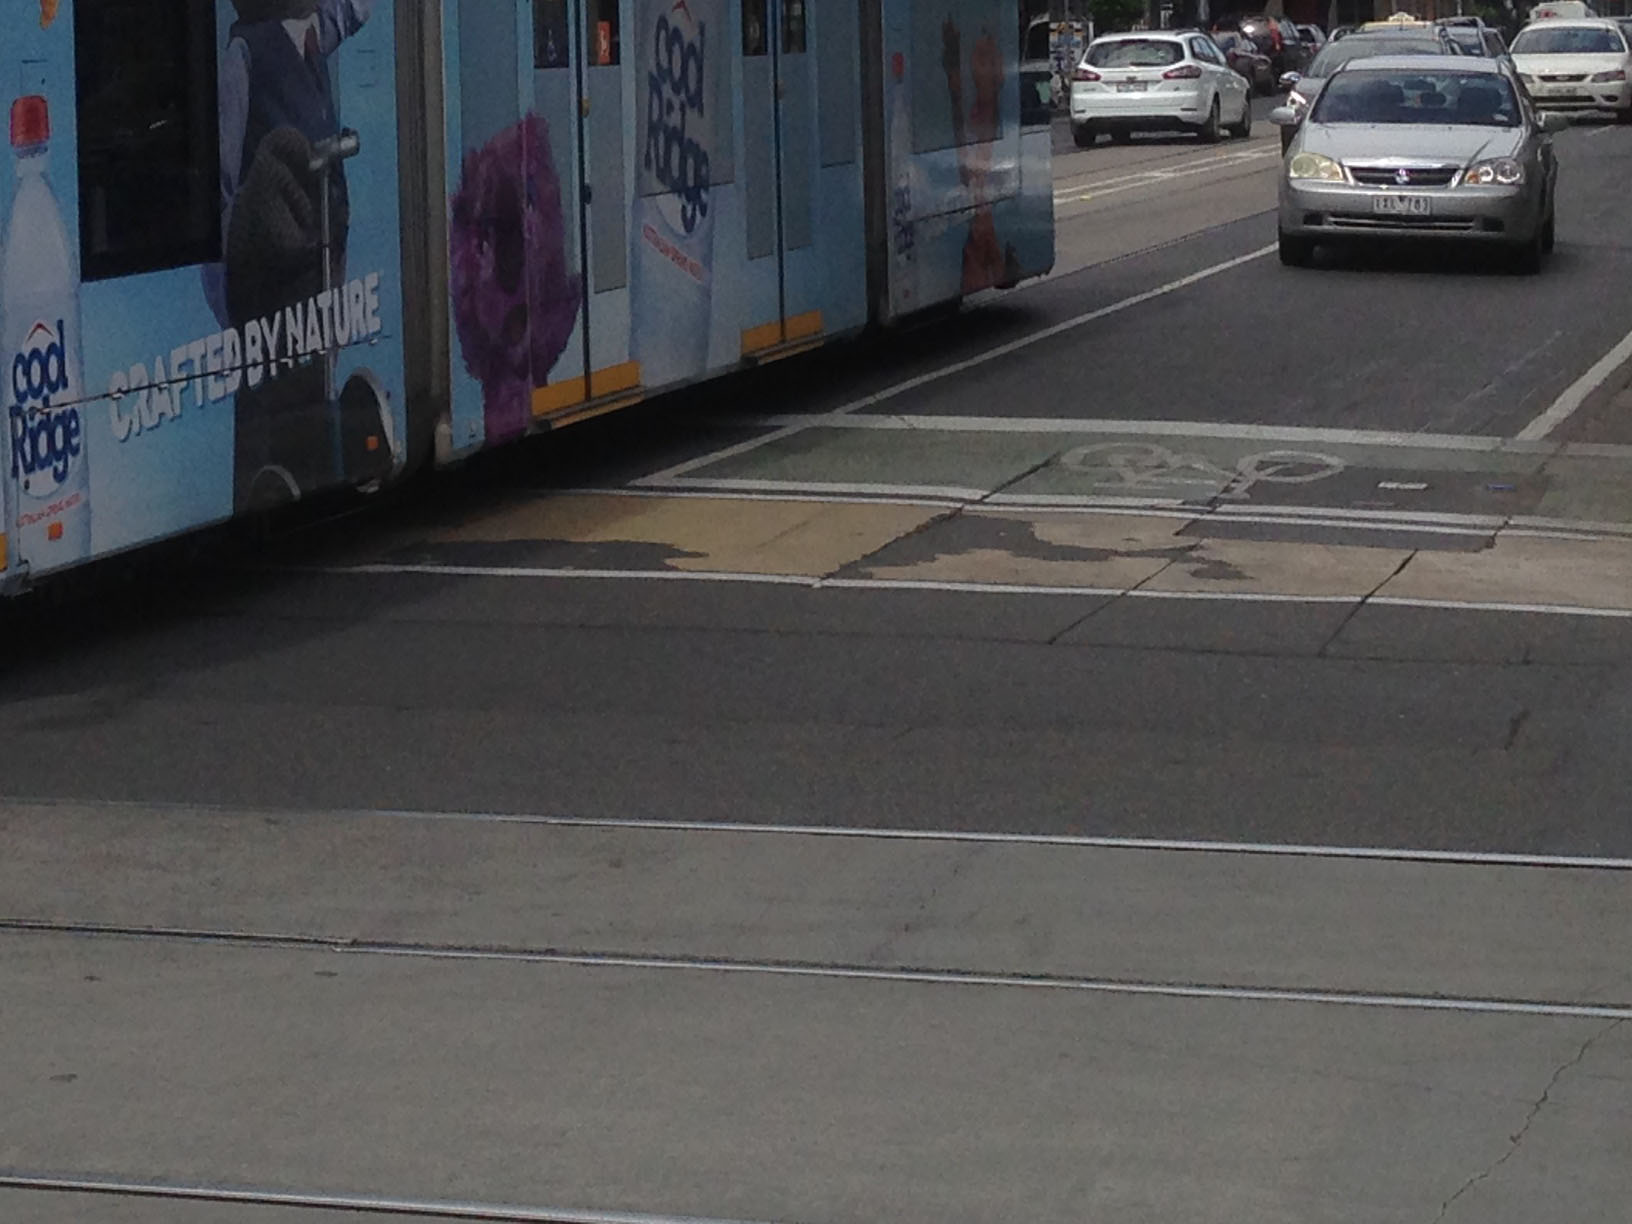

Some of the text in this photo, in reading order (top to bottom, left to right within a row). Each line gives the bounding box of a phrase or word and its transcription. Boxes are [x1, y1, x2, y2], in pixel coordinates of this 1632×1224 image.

[645, 70, 709, 233] Ridge
[9, 394, 81, 483] Ridge
[108, 271, 382, 443] CRAFTED BY NATURE
